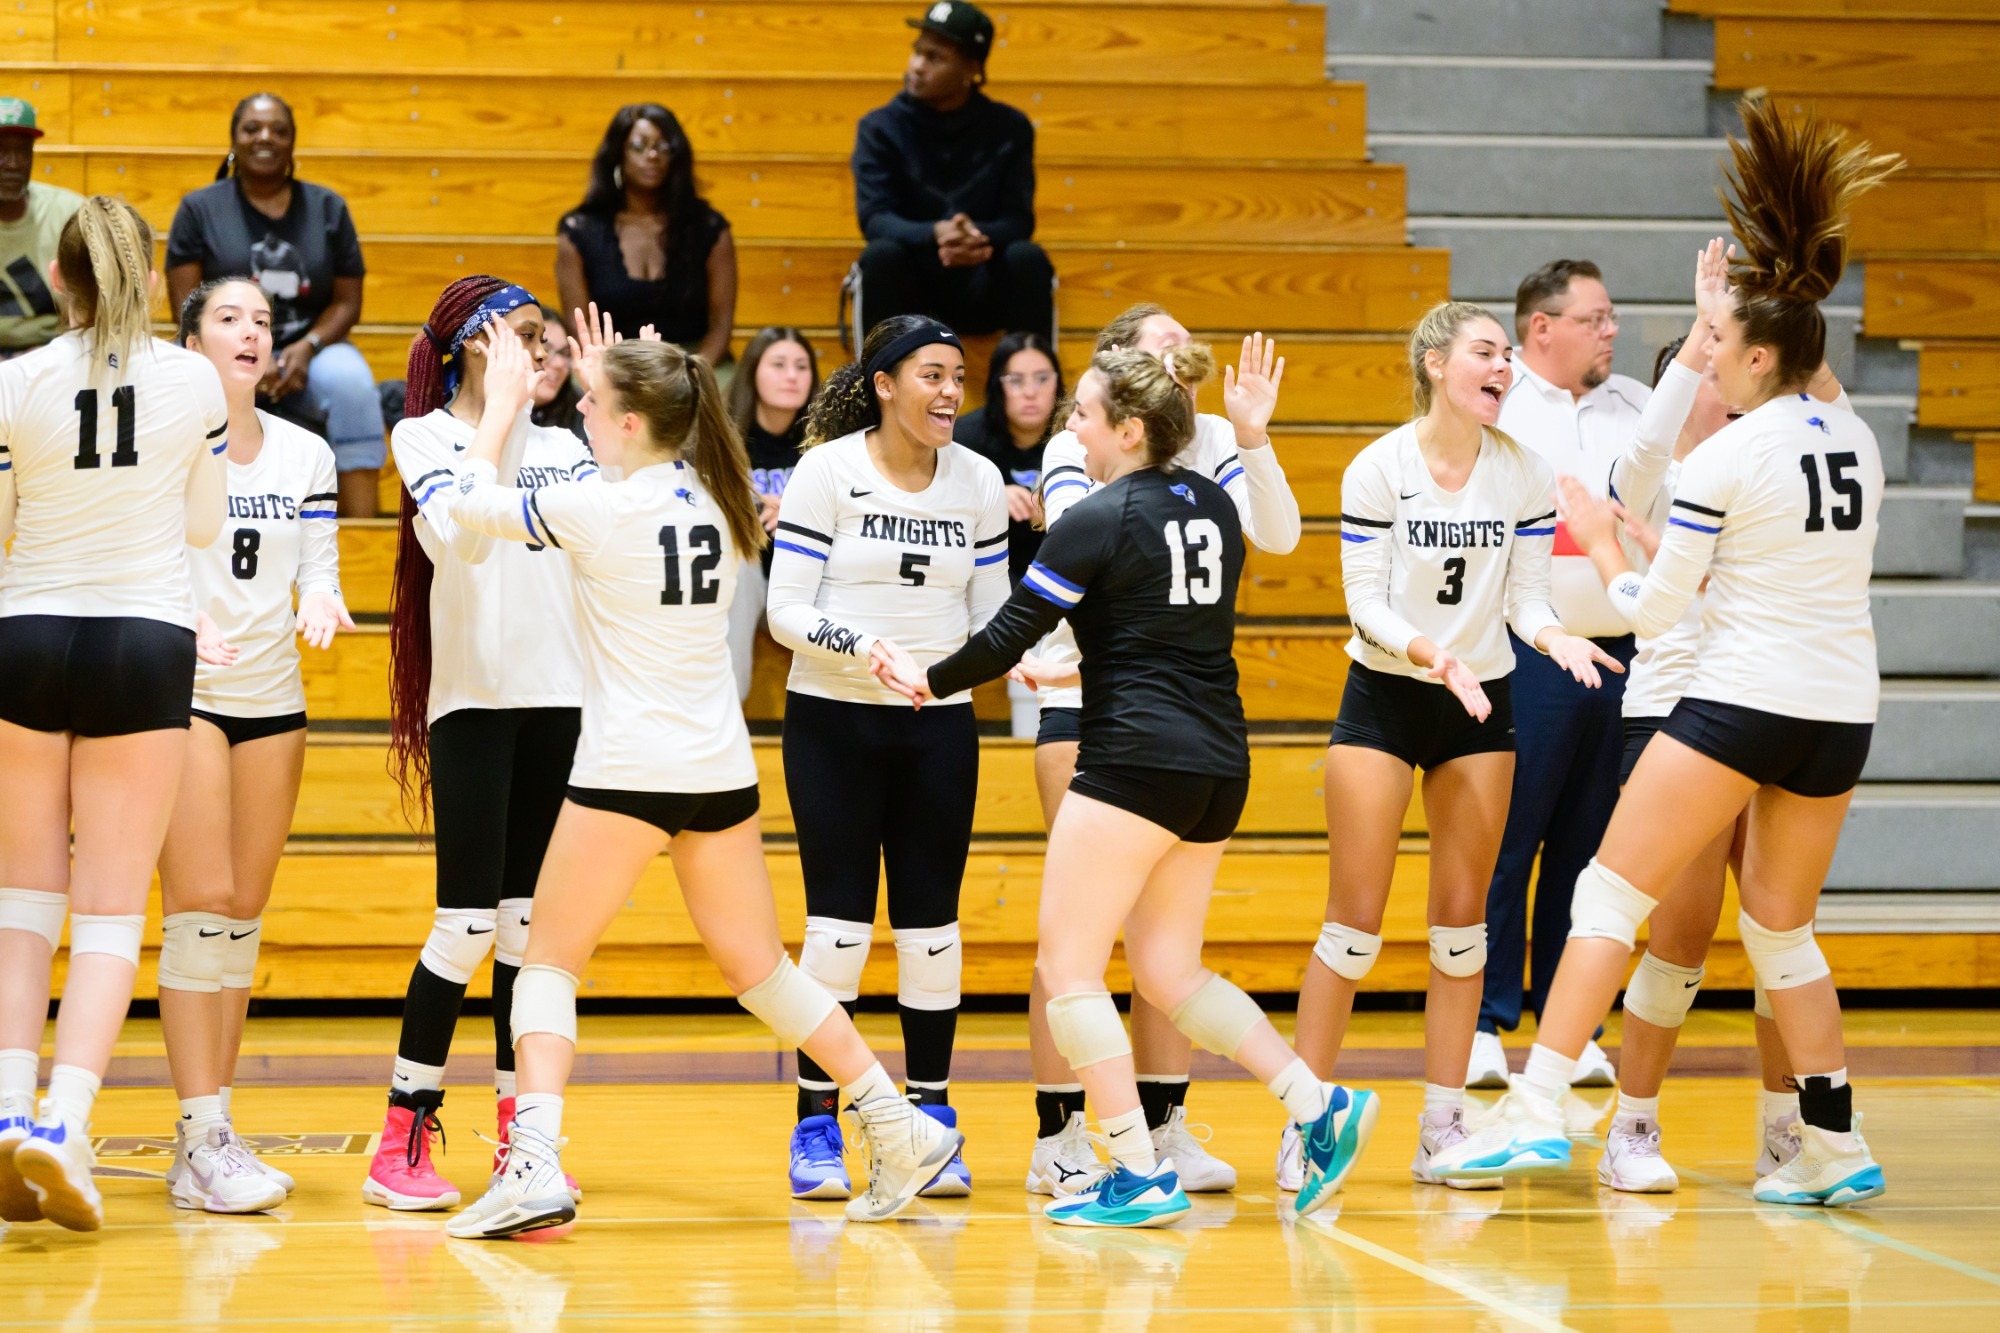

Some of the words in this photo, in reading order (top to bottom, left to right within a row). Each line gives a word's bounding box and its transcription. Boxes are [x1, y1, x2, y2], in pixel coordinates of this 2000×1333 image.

[74, 385, 138, 470] 11
[1799, 451, 1863, 532] 15
[231, 527, 261, 580] 8
[860, 514, 967, 548] KNIGHTS
[1406, 519, 1505, 548] KNIGHTS
[658, 524, 722, 606] 12
[898, 552, 931, 587] 5
[1163, 518, 1223, 605] 13
[1436, 556, 1467, 606] 3
